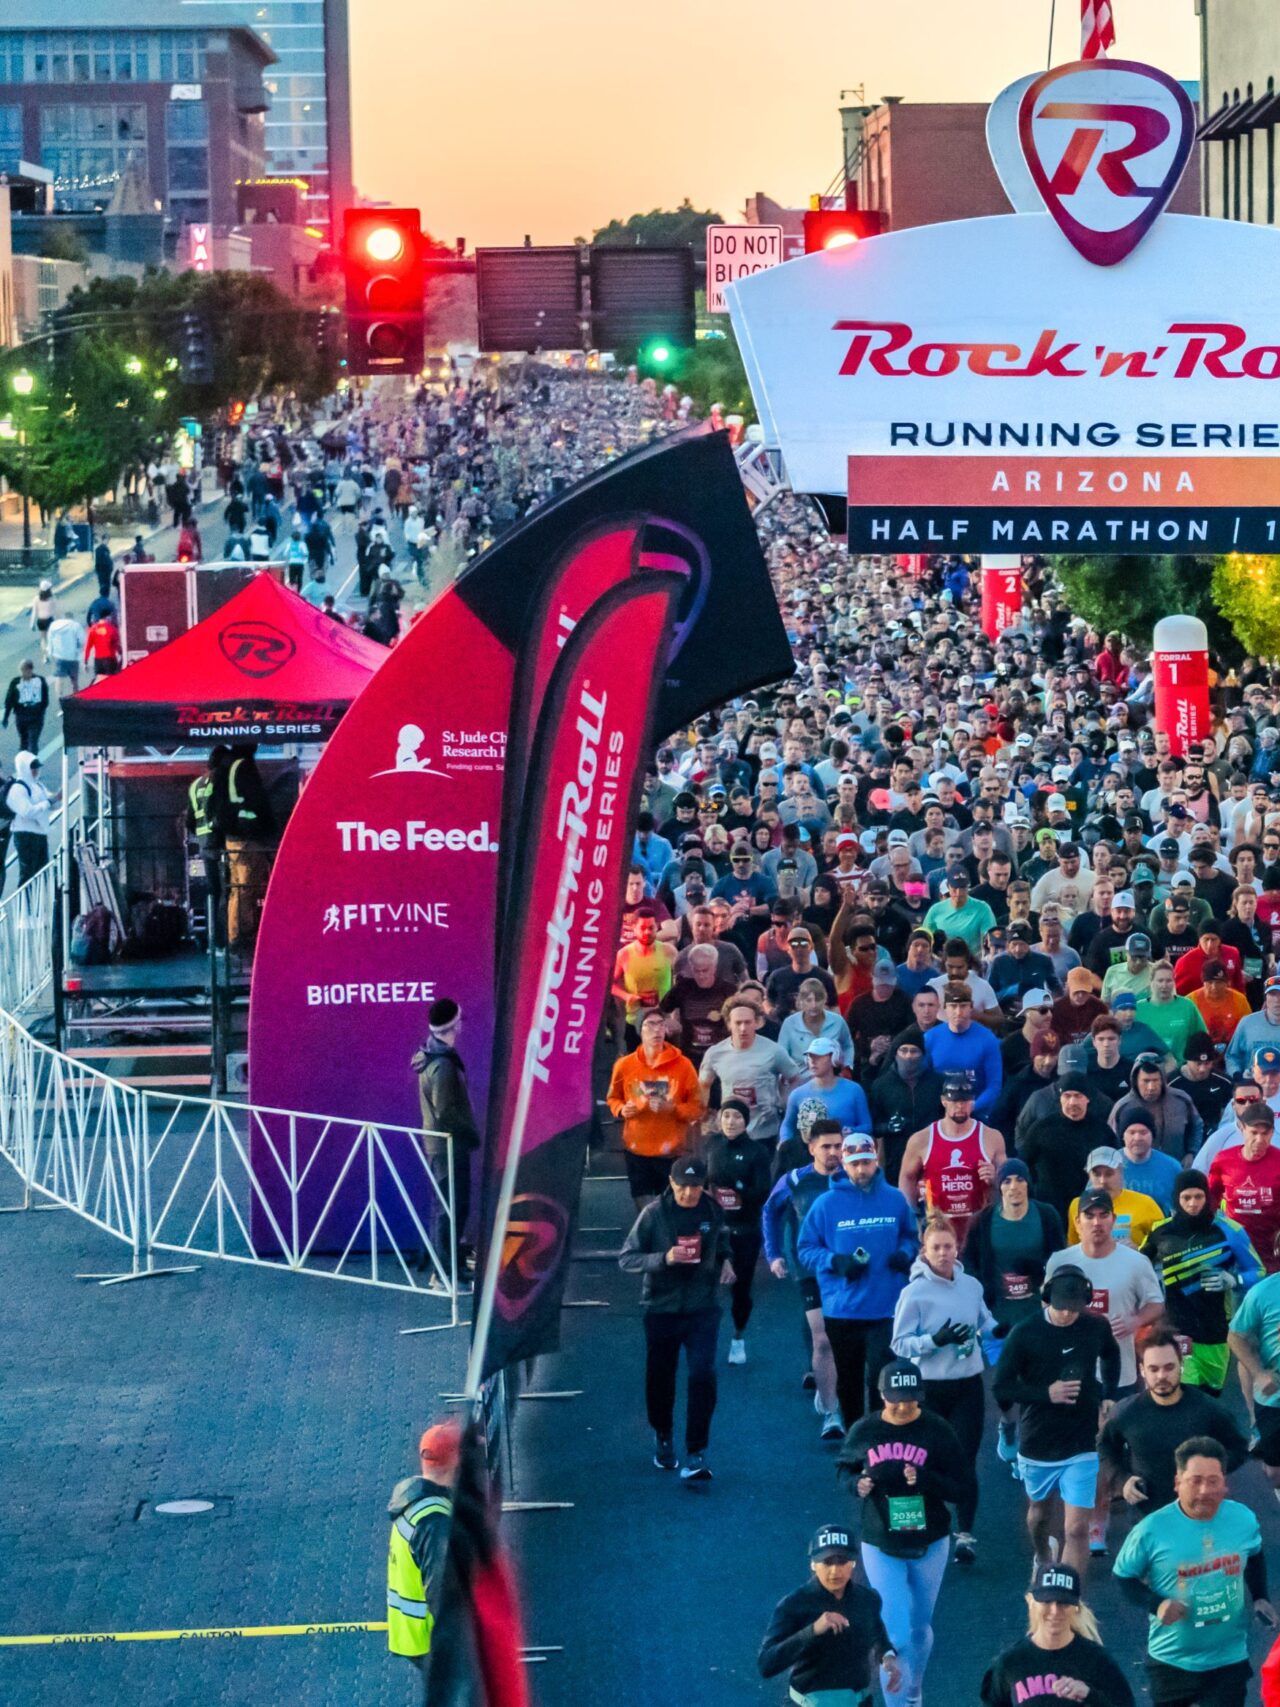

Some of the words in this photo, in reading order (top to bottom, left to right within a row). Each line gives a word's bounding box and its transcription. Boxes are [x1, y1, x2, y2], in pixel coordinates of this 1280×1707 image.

[714, 236, 737, 254] DO
[744, 236, 777, 254] NOT
[715, 264, 776, 282] BLO
[889, 421, 1120, 448] RUNNING
[991, 471, 1196, 492] ARIZONA
[871, 519, 970, 541] HALF
[991, 519, 1209, 541] MARATHON
[1004, 577, 1016, 592] 2
[1159, 653, 1192, 662] CORRAL
[1168, 663, 1178, 685] 1
[189, 726, 262, 737] RUNNING
[264, 724, 322, 735] SERIES
[442, 730, 459, 744] St.
[459, 730, 488, 746] Jude
[442, 745, 499, 758] Research
[593, 730, 625, 868] SERIES
[336, 821, 402, 852] The
[406, 820, 500, 853] Feed.
[344, 902, 450, 931] FITVINE
[563, 882, 604, 1054] RUNNING
[941, 1181, 974, 1193] HERO
[955, 1174, 973, 1182] Jude
[836, 1219, 857, 1228] CAL
[859, 1216, 897, 1225] BAPTIST
[867, 1441, 929, 1468] AMOUR
[1015, 1673, 1058, 1704] AMO
